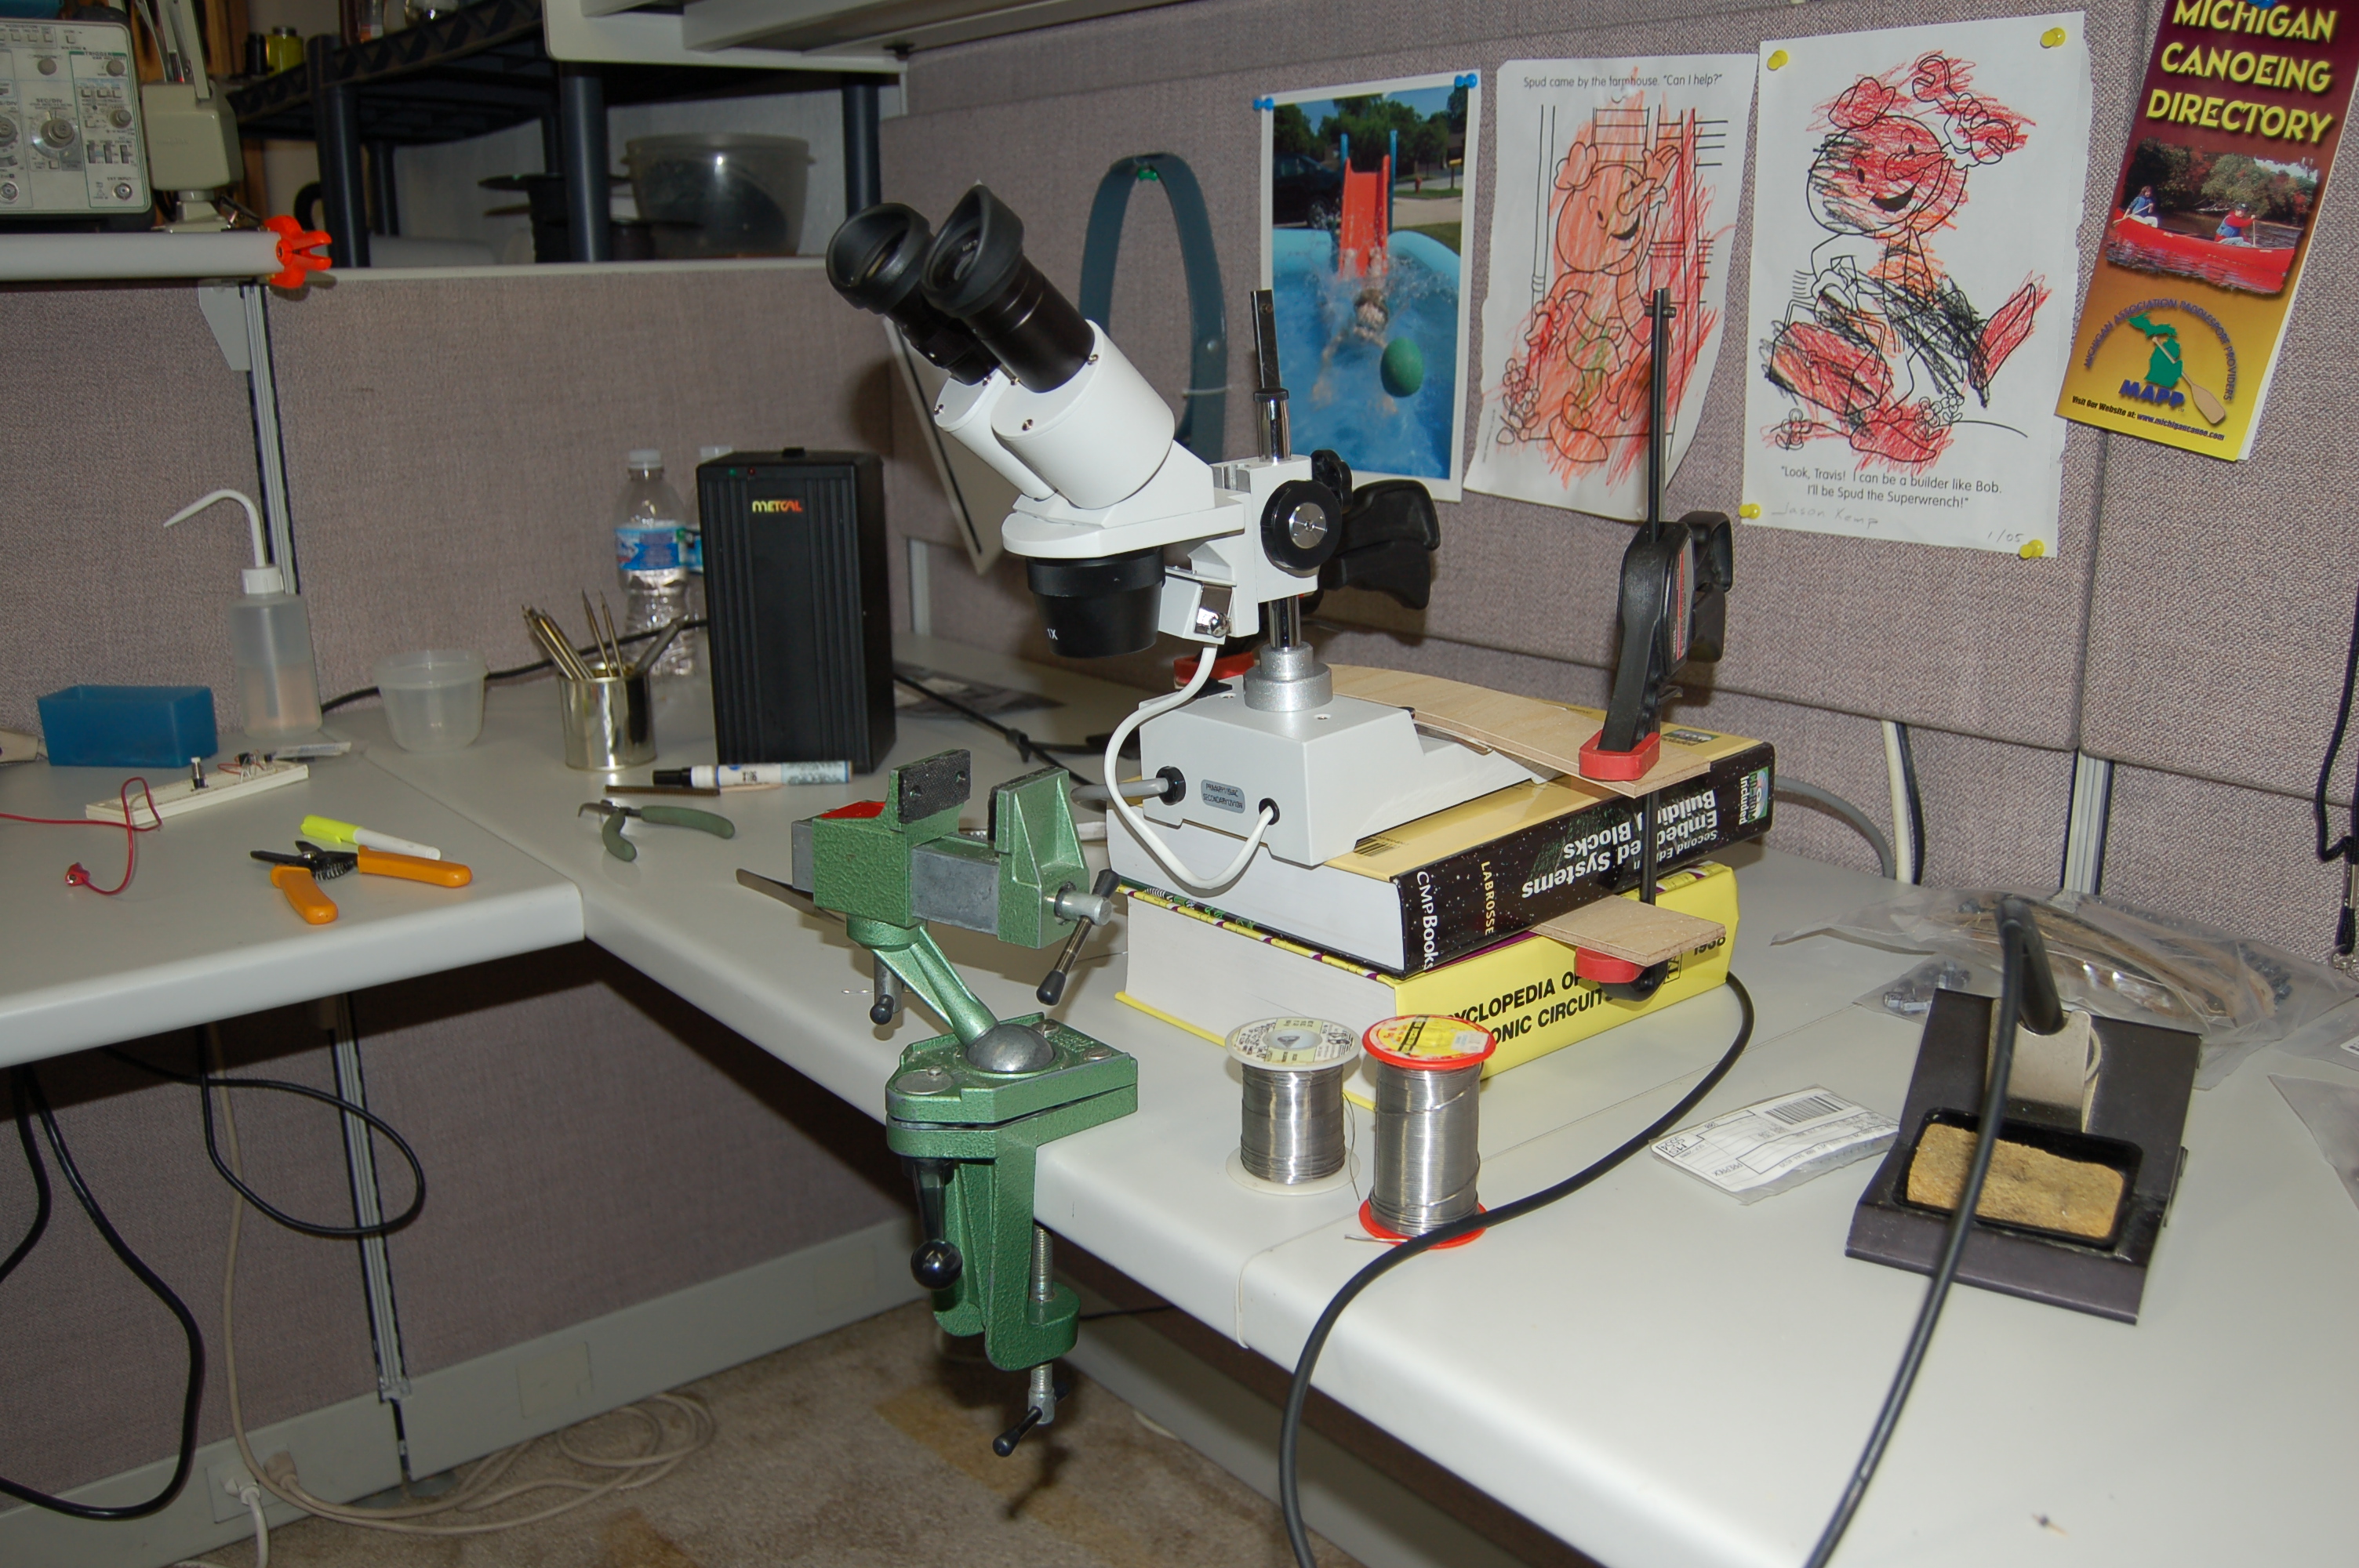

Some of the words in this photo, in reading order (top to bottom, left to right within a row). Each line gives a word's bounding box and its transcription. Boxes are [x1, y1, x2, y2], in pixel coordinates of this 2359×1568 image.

[2172, 0, 2337, 43] MICHIGAN
[1523, 75, 1547, 90] Spud
[1549, 78, 1575, 87] came
[1577, 75, 1590, 89] by
[1591, 75, 1607, 86] the
[2161, 42, 2332, 93] CANOEING
[2146, 88, 2333, 143] DIRECTORY
[2084, 320, 2115, 369] MICHIGAN
[2114, 298, 2177, 327] ASSOCIATION
[2179, 299, 2231, 345] PADDLESPORT
[2223, 345, 2237, 401] PROVIDERS
[2118, 378, 2185, 408] MAPP
[2072, 395, 2085, 405] Visit
[2086, 399, 2098, 409] Our
[2099, 402, 2127, 416] Website
[2136, 413, 2225, 441] www.michigancanoe.com
[1807, 485, 1818, 495] I'll
[1821, 485, 1834, 497] be
[1837, 486, 1864, 501] Spud
[1867, 489, 1884, 501] the
[1814, 468, 1846, 481] Travis!
[1859, 474, 1878, 484] can
[1882, 473, 1896, 485] be
[1899, 477, 1906, 486] a
[1910, 475, 1949, 489] builder
[1952, 478, 1972, 491] like
[1976, 480, 2002, 494] Bob.
[752, 499, 803, 514] METCAL
[1771, 502, 1825, 517] Jason
[1834, 507, 1879, 529] Kemp
[1047, 628, 1059, 640] 1X
[1738, 775, 1751, 826] Included
[1748, 773, 1758, 821] CD-ROM
[1562, 821, 1632, 860] Blocks
[1617, 809, 1717, 865] Embeded
[1676, 829, 1718, 855] Second
[1521, 851, 1611, 898] Systems
[1481, 861, 1496, 937] LABROSSE
[1448, 978, 1556, 1024] YCLOPEDIA
[1537, 988, 1612, 1028] CIRCUIT
